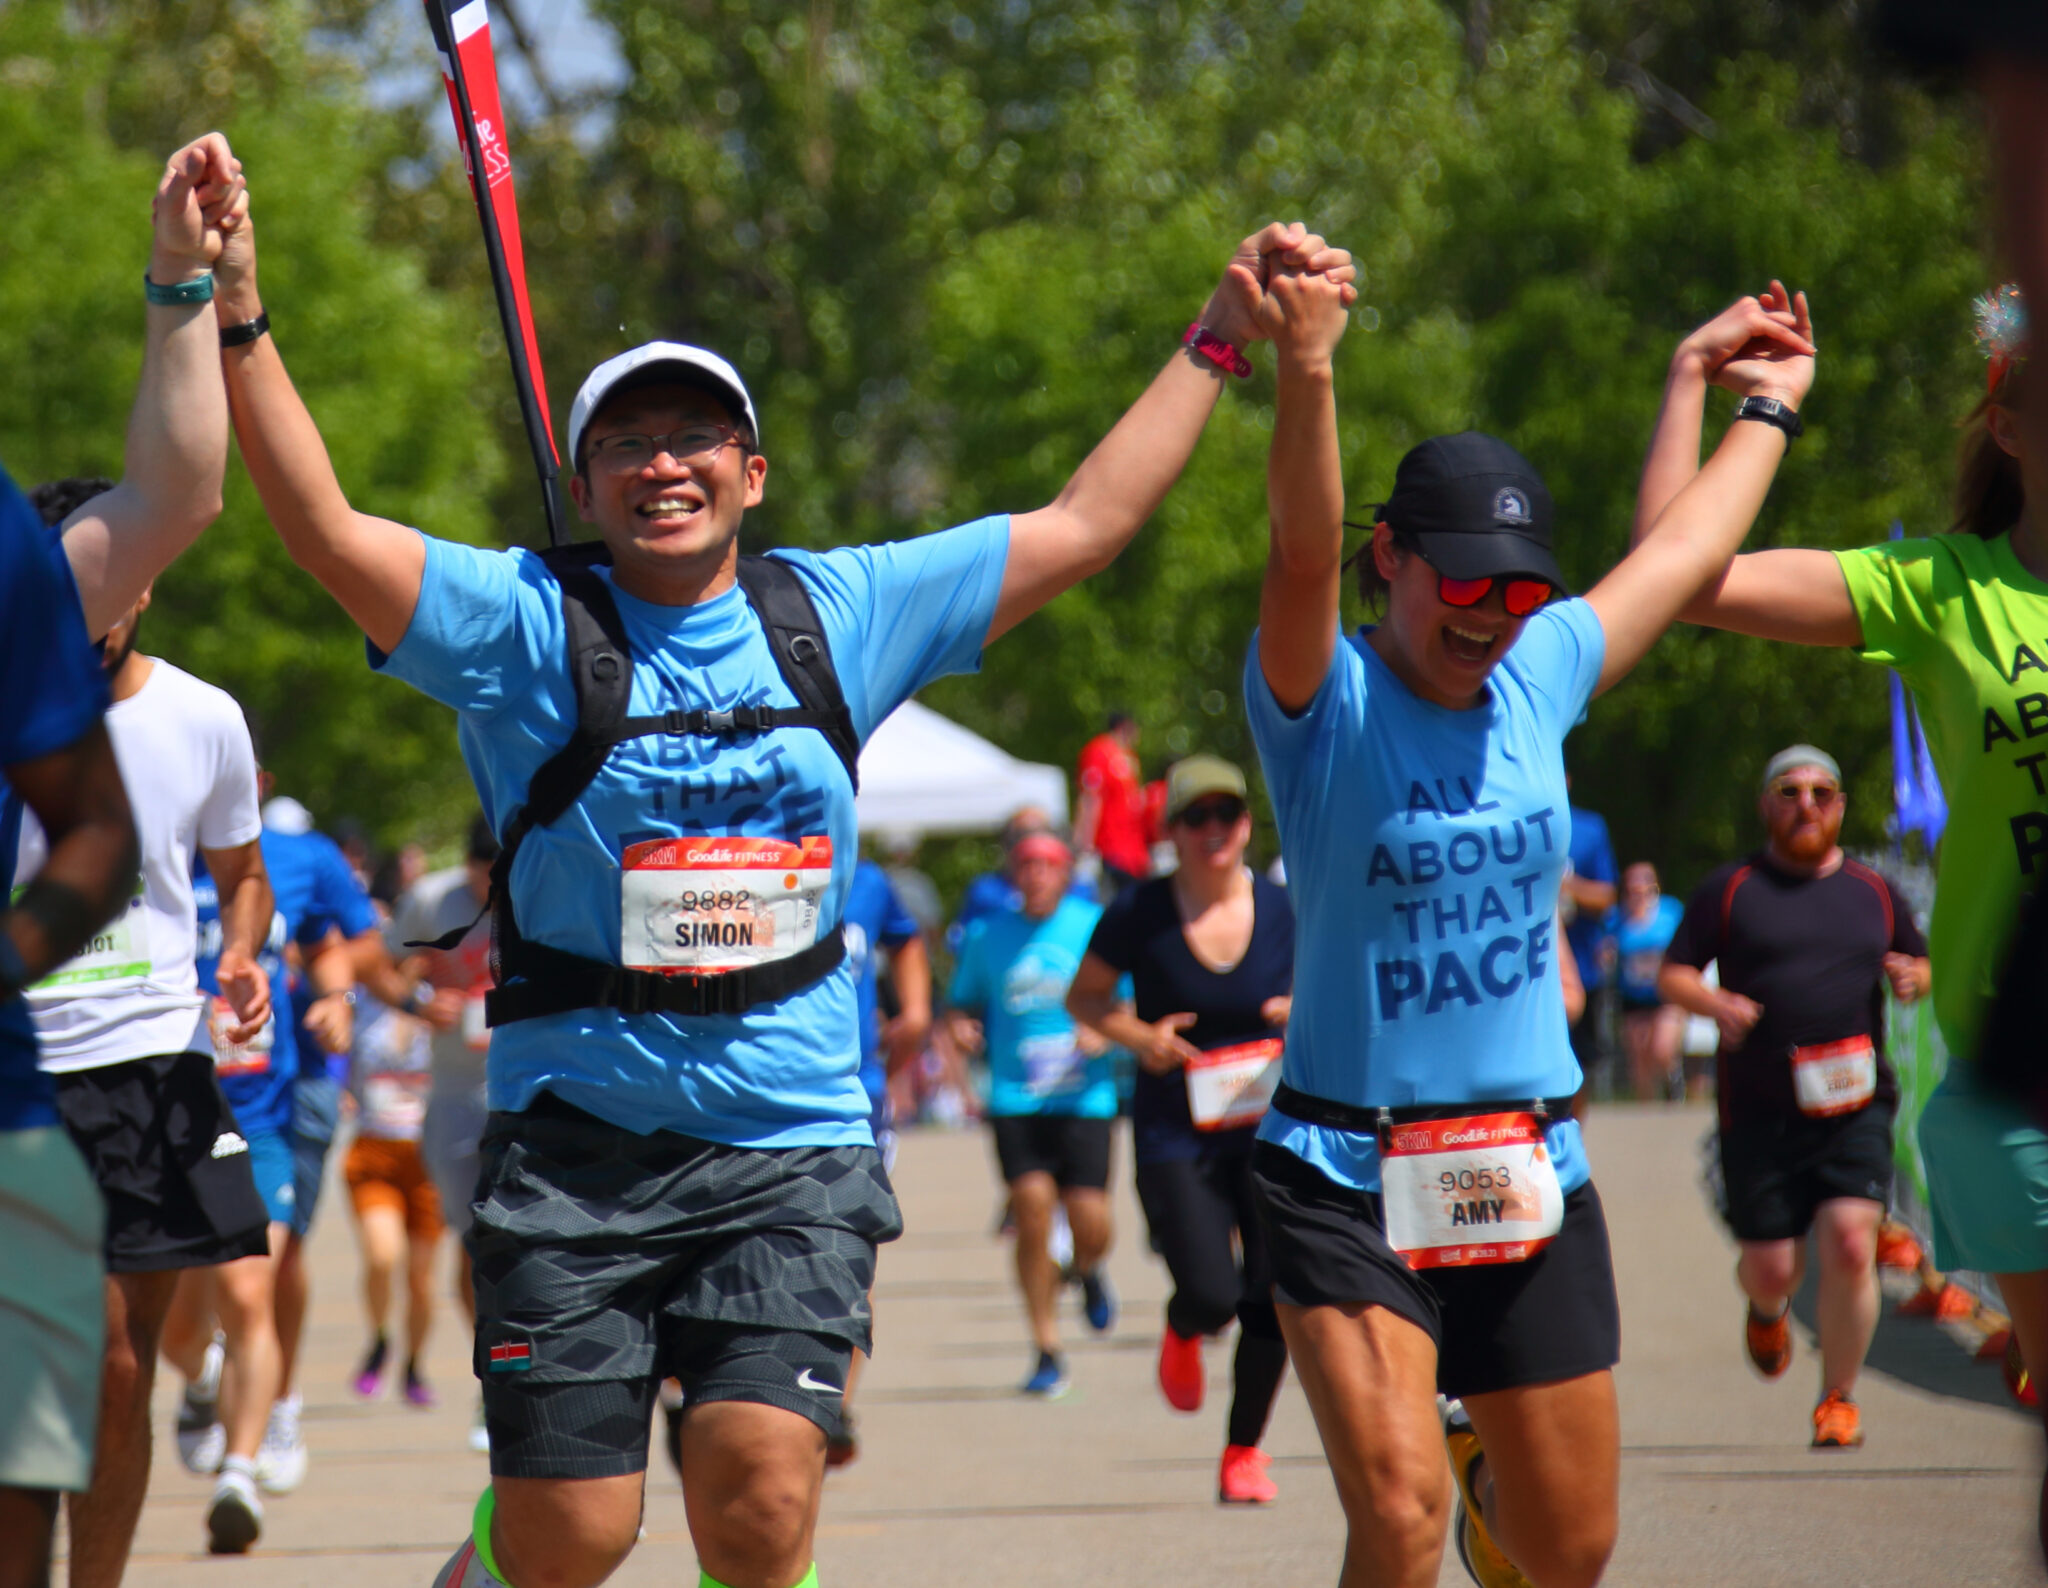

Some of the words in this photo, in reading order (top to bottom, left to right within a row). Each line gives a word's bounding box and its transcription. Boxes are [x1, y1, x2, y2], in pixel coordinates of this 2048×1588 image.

[640, 745, 804, 816] THAT
[1405, 776, 1500, 825] ALL
[686, 847, 733, 863] GoodLife
[734, 850, 781, 862] FITNESS
[1366, 806, 1554, 887] ABOUT
[681, 890, 751, 911] 9882
[1393, 867, 1542, 943] THAT
[675, 922, 754, 947] SIMON
[1375, 919, 1551, 1021] PACE
[1442, 1125, 1489, 1145] GoodLife
[1490, 1126, 1528, 1140] FITNESS
[1439, 1166, 1511, 1192] 9053
[1452, 1199, 1506, 1227] AMY
